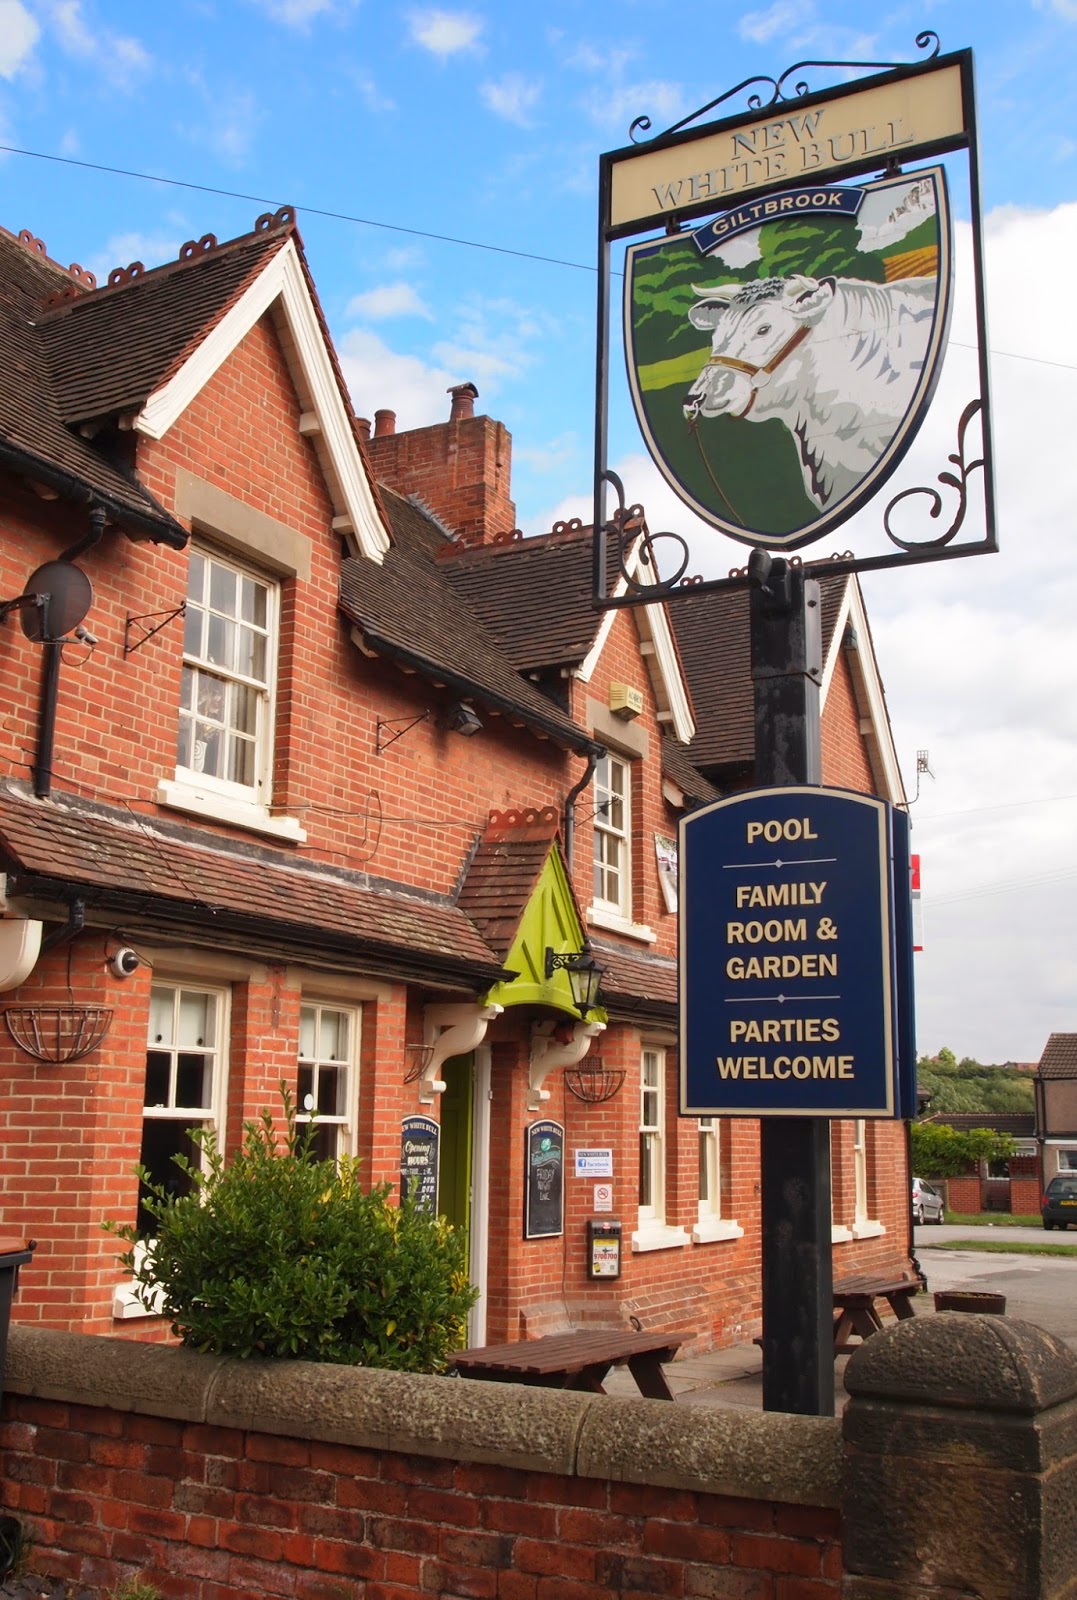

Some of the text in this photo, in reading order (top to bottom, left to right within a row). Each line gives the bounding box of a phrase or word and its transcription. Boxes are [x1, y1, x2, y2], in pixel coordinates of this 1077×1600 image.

[731, 109, 826, 161] NEW
[651, 119, 914, 209] WHITE BULL
[711, 192, 843, 235] GILTBROOK
[747, 818, 818, 844] POOL
[736, 882, 827, 908] FAMILY
[727, 917, 838, 944] ROOM &
[726, 954, 837, 979] GARDEN
[730, 1018, 840, 1043] PARTIES
[717, 1055, 854, 1080] WELCOME
[410, 1122, 425, 1130] WHITE
[426, 1124, 437, 1135] BULL
[531, 1127, 540, 1136] NEW
[552, 1127, 562, 1137] BULL
